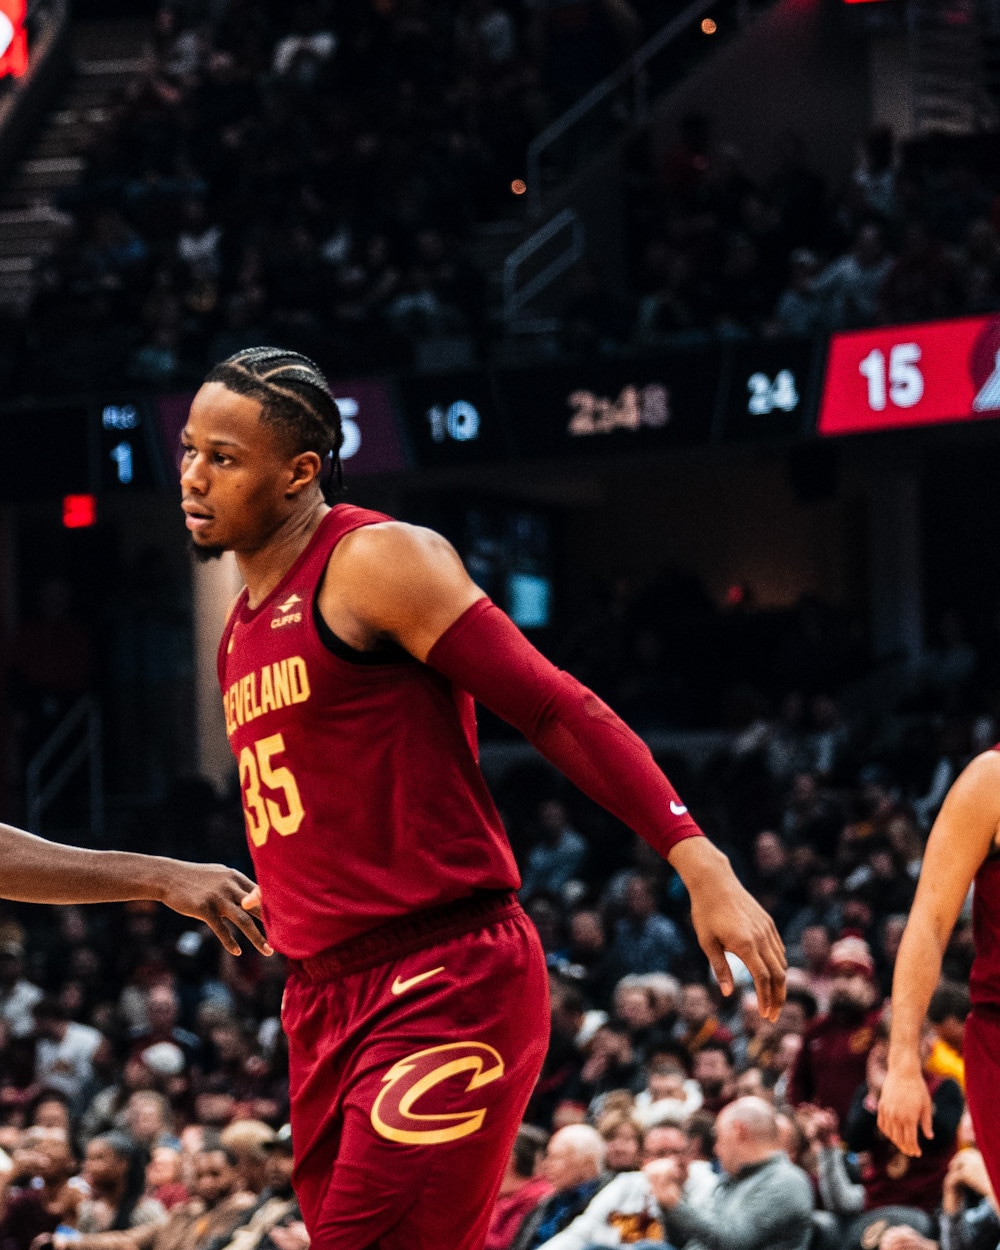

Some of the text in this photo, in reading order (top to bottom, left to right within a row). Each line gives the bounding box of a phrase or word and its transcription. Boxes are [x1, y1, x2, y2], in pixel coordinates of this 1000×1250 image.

[747, 368, 800, 416] 24
[858, 341, 925, 412] 15
[109, 439, 134, 485] 1
[270, 612, 302, 629] CLIFFS
[223, 655, 311, 738] LEVELAND
[238, 732, 306, 848] 35
[370, 1040, 505, 1146] C
